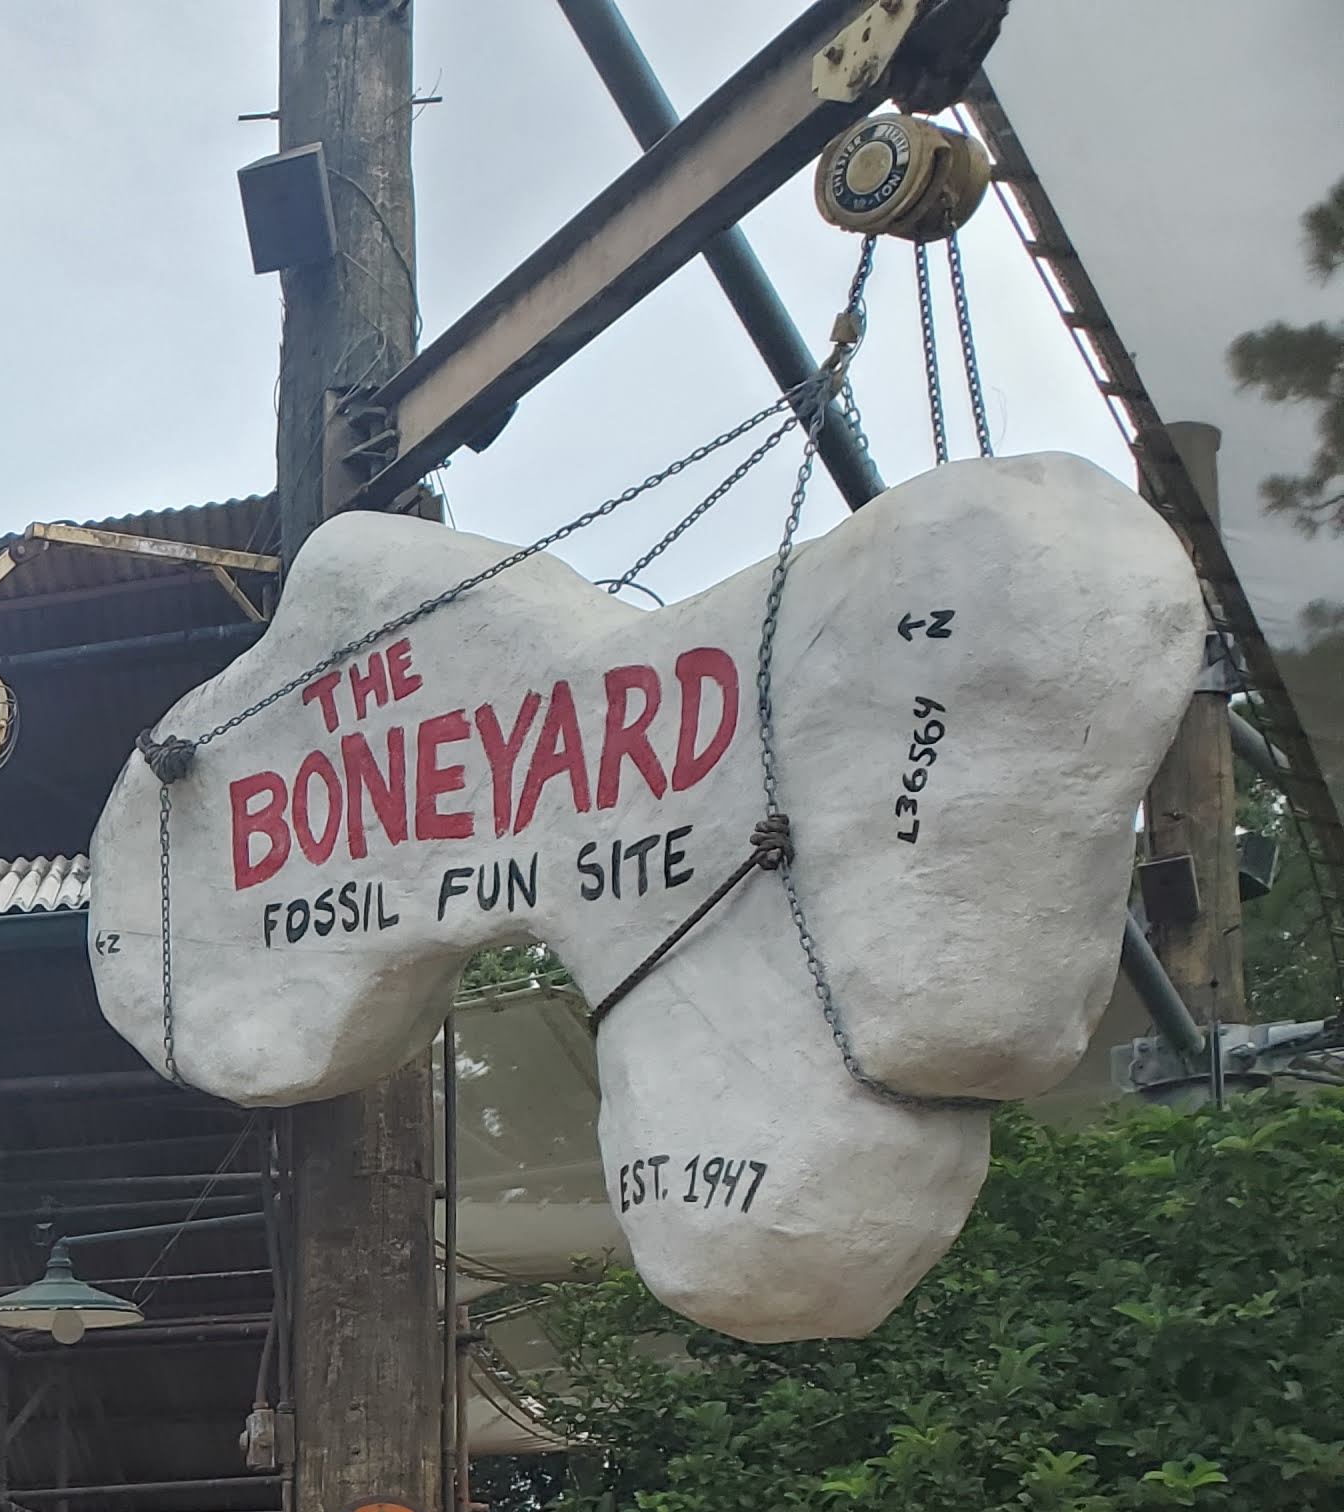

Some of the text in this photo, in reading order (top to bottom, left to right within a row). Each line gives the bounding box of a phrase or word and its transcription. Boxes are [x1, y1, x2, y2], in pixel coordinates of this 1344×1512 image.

[302, 640, 422, 735] THE
[228, 645, 739, 891] BONEYARD
[262, 824, 696, 949] FOSSIL FUN SITE
[619, 1154, 769, 1214] EST. 1947
